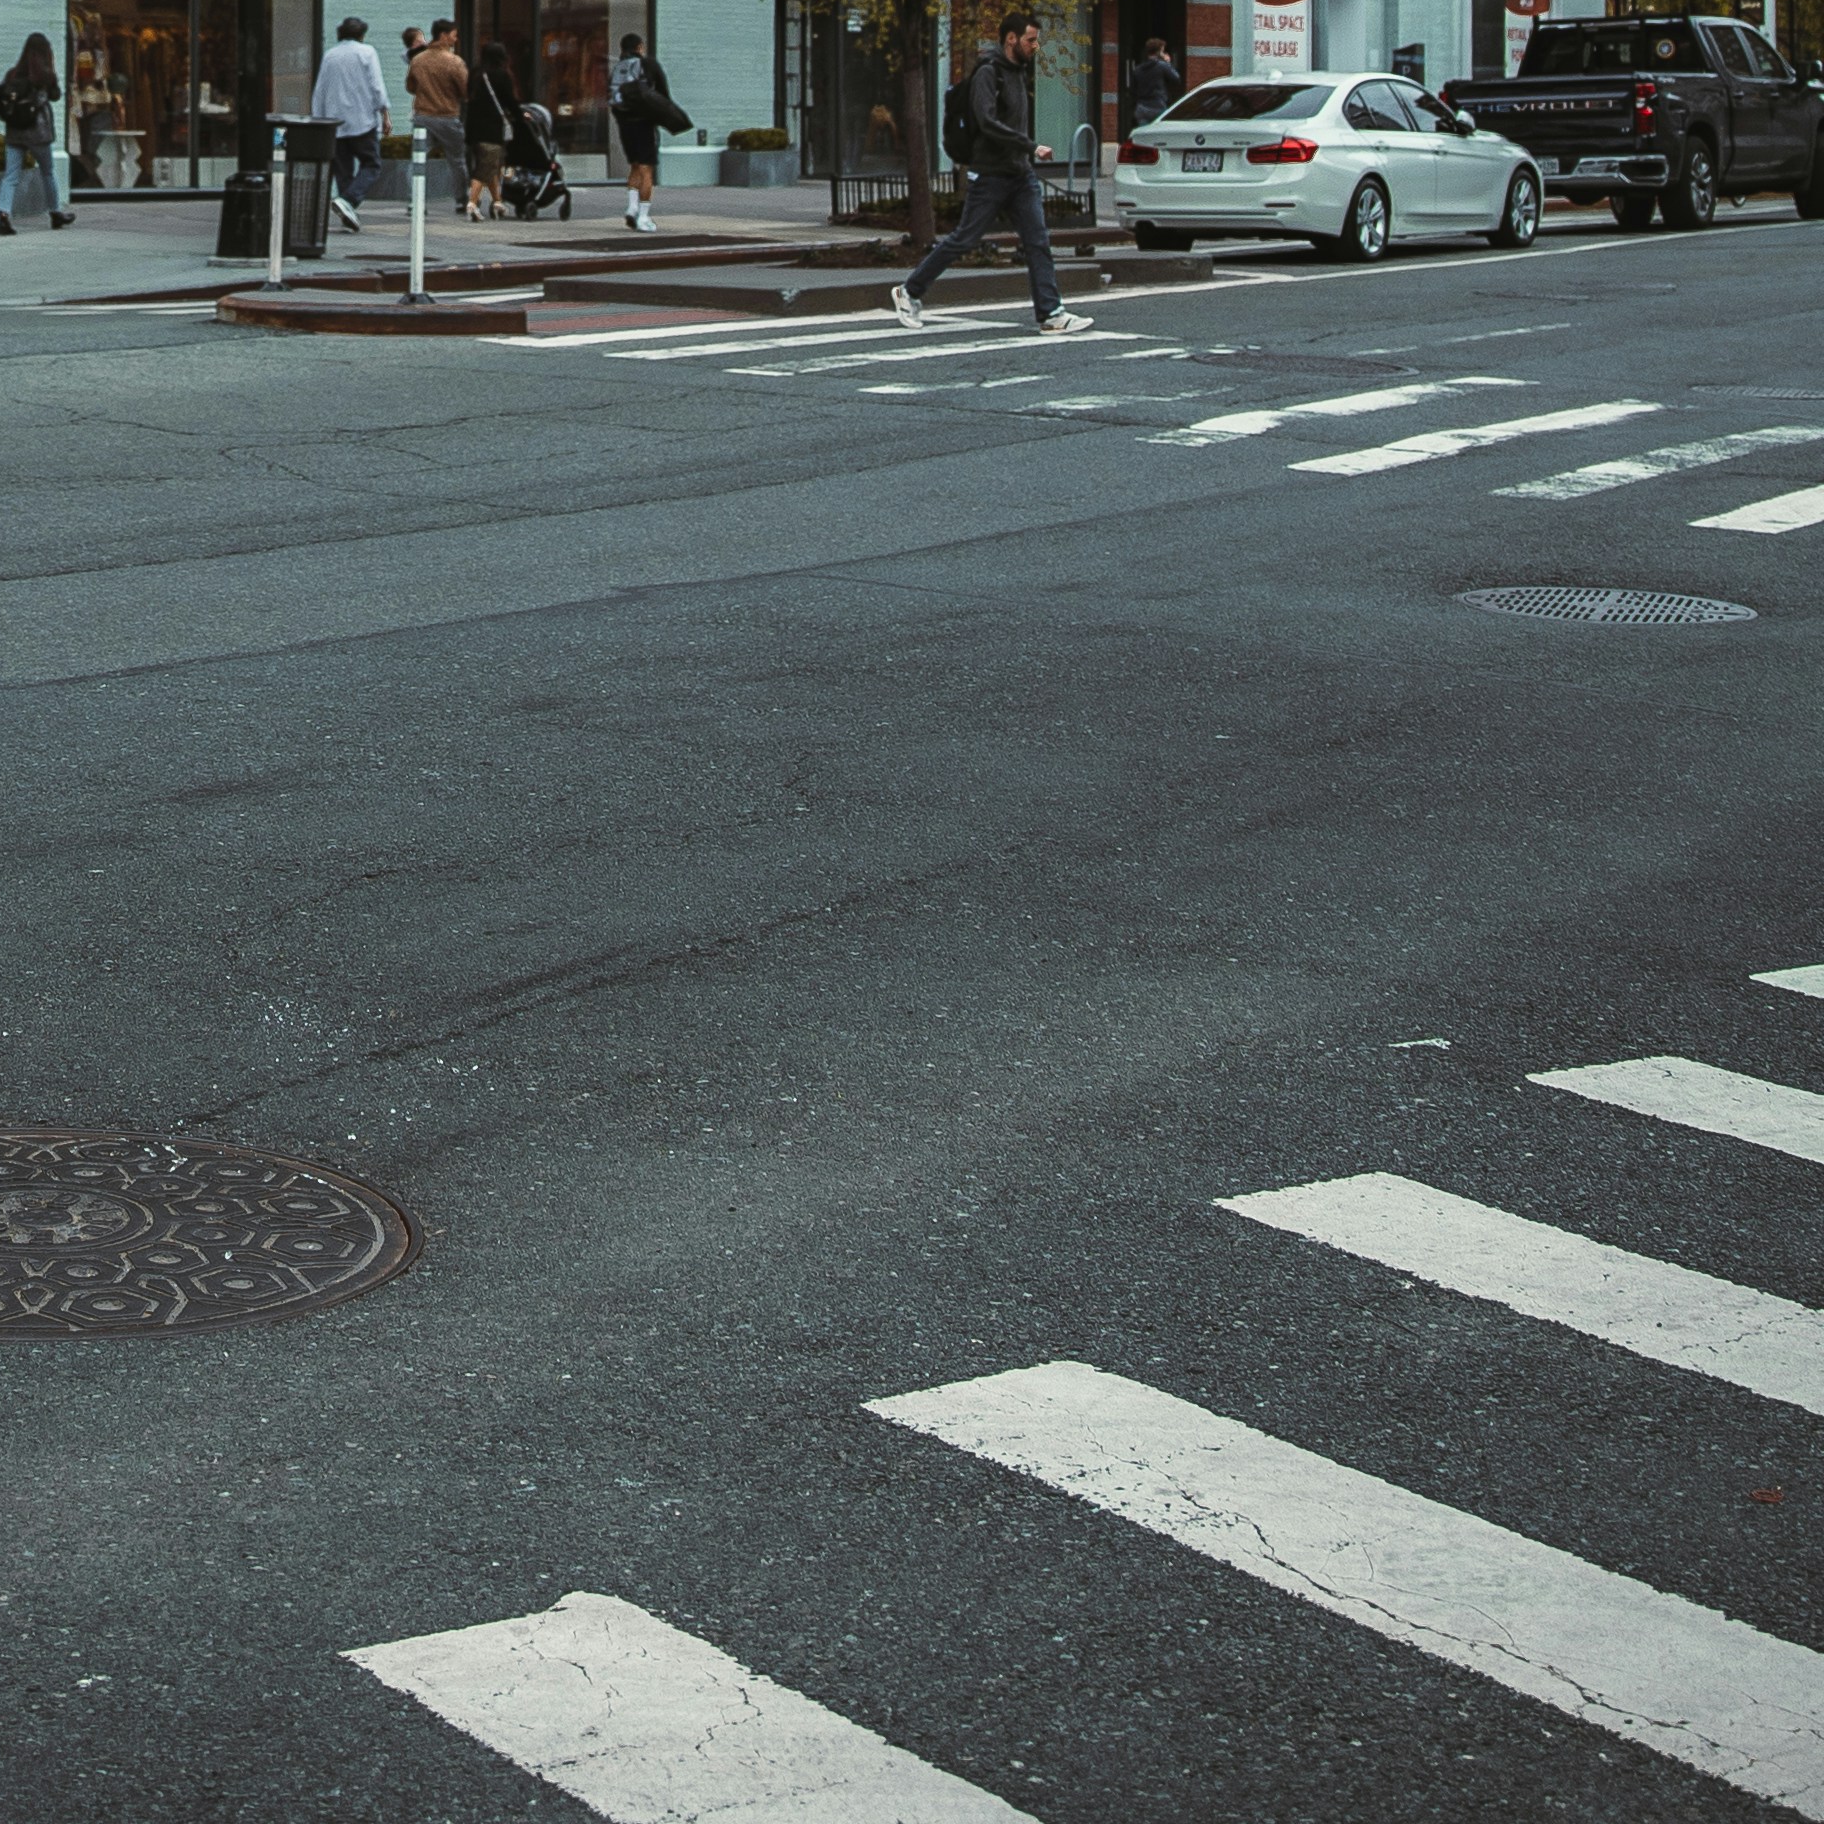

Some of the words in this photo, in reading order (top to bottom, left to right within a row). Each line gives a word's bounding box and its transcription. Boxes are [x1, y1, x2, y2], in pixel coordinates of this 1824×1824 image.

[1254, 14, 1275, 31] ETAIL
[1278, 15, 1304, 32] SPACE
[1273, 40, 1298, 58] LEASE
[1462, 100, 1622, 113] CHEVROLET
